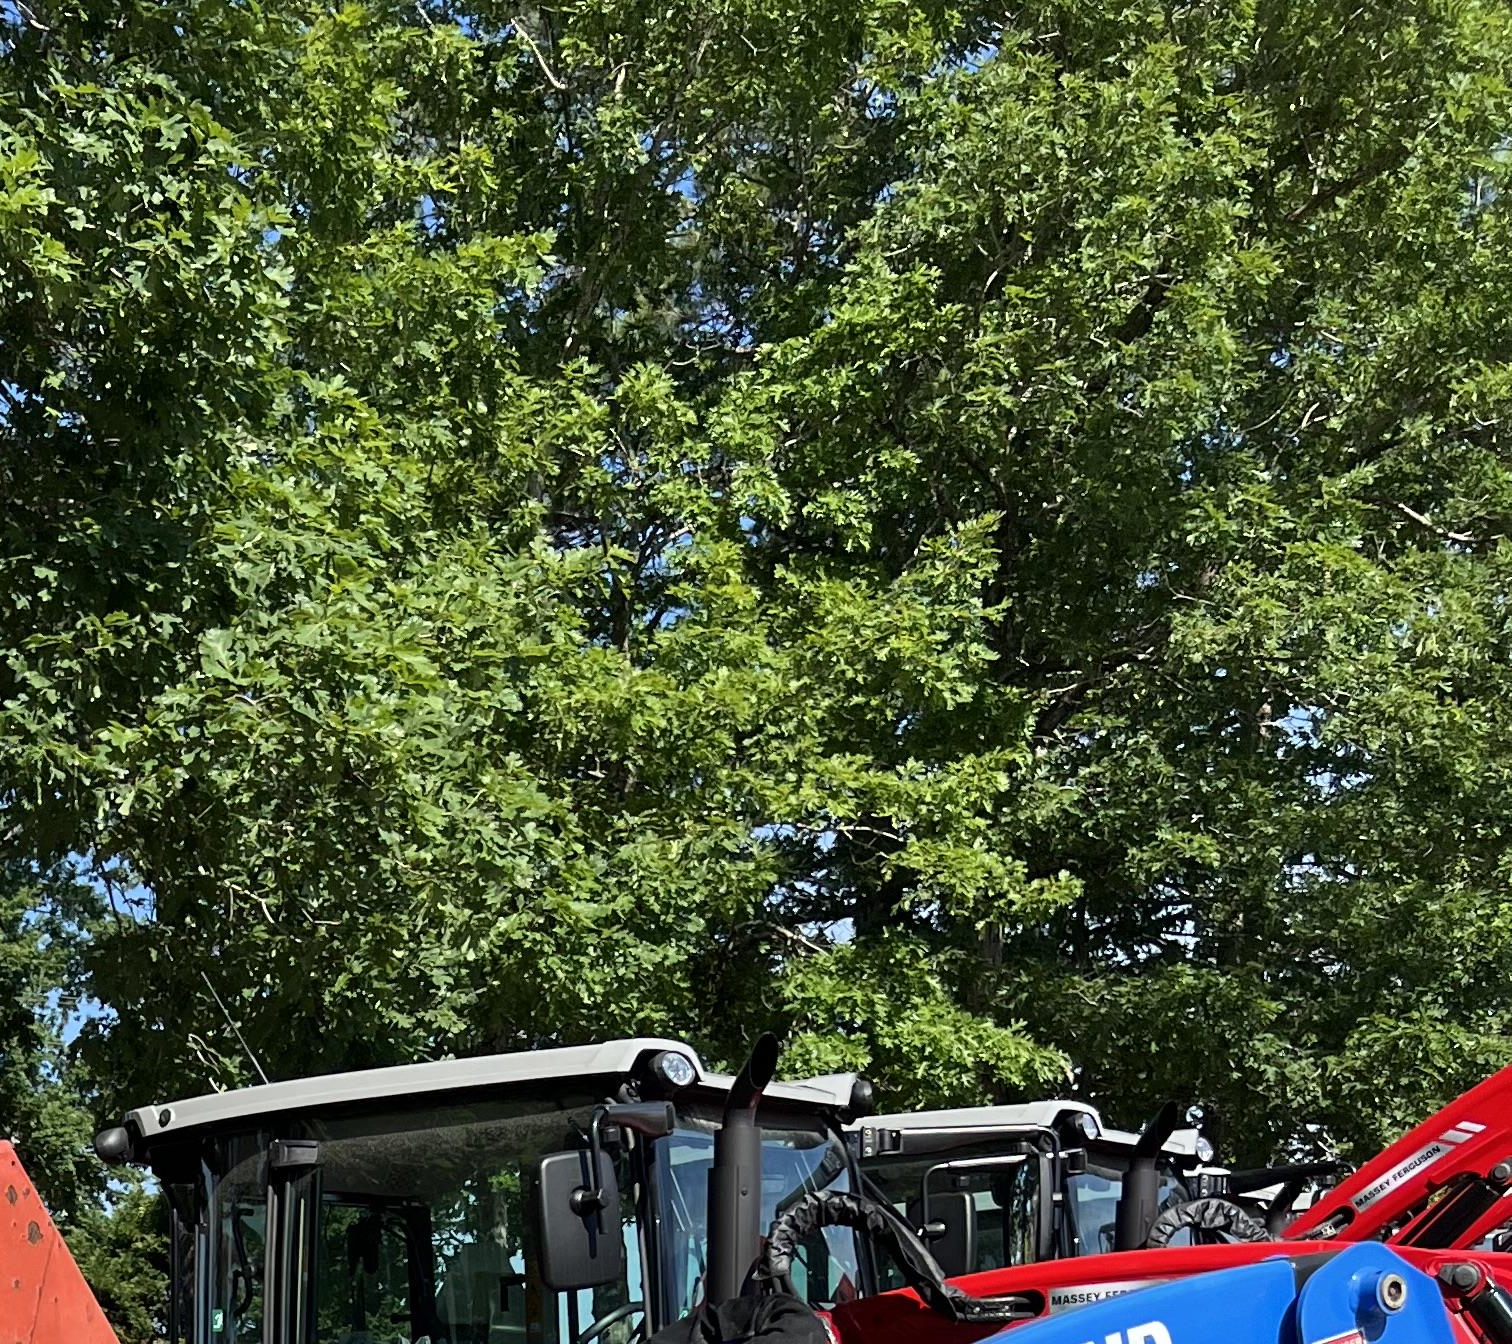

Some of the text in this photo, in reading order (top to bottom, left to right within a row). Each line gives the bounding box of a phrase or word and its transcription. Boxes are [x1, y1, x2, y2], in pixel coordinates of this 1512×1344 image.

[1355, 1144, 1442, 1208] MASSEY FERGUSON
[1051, 1291, 1101, 1306] MASSEY
